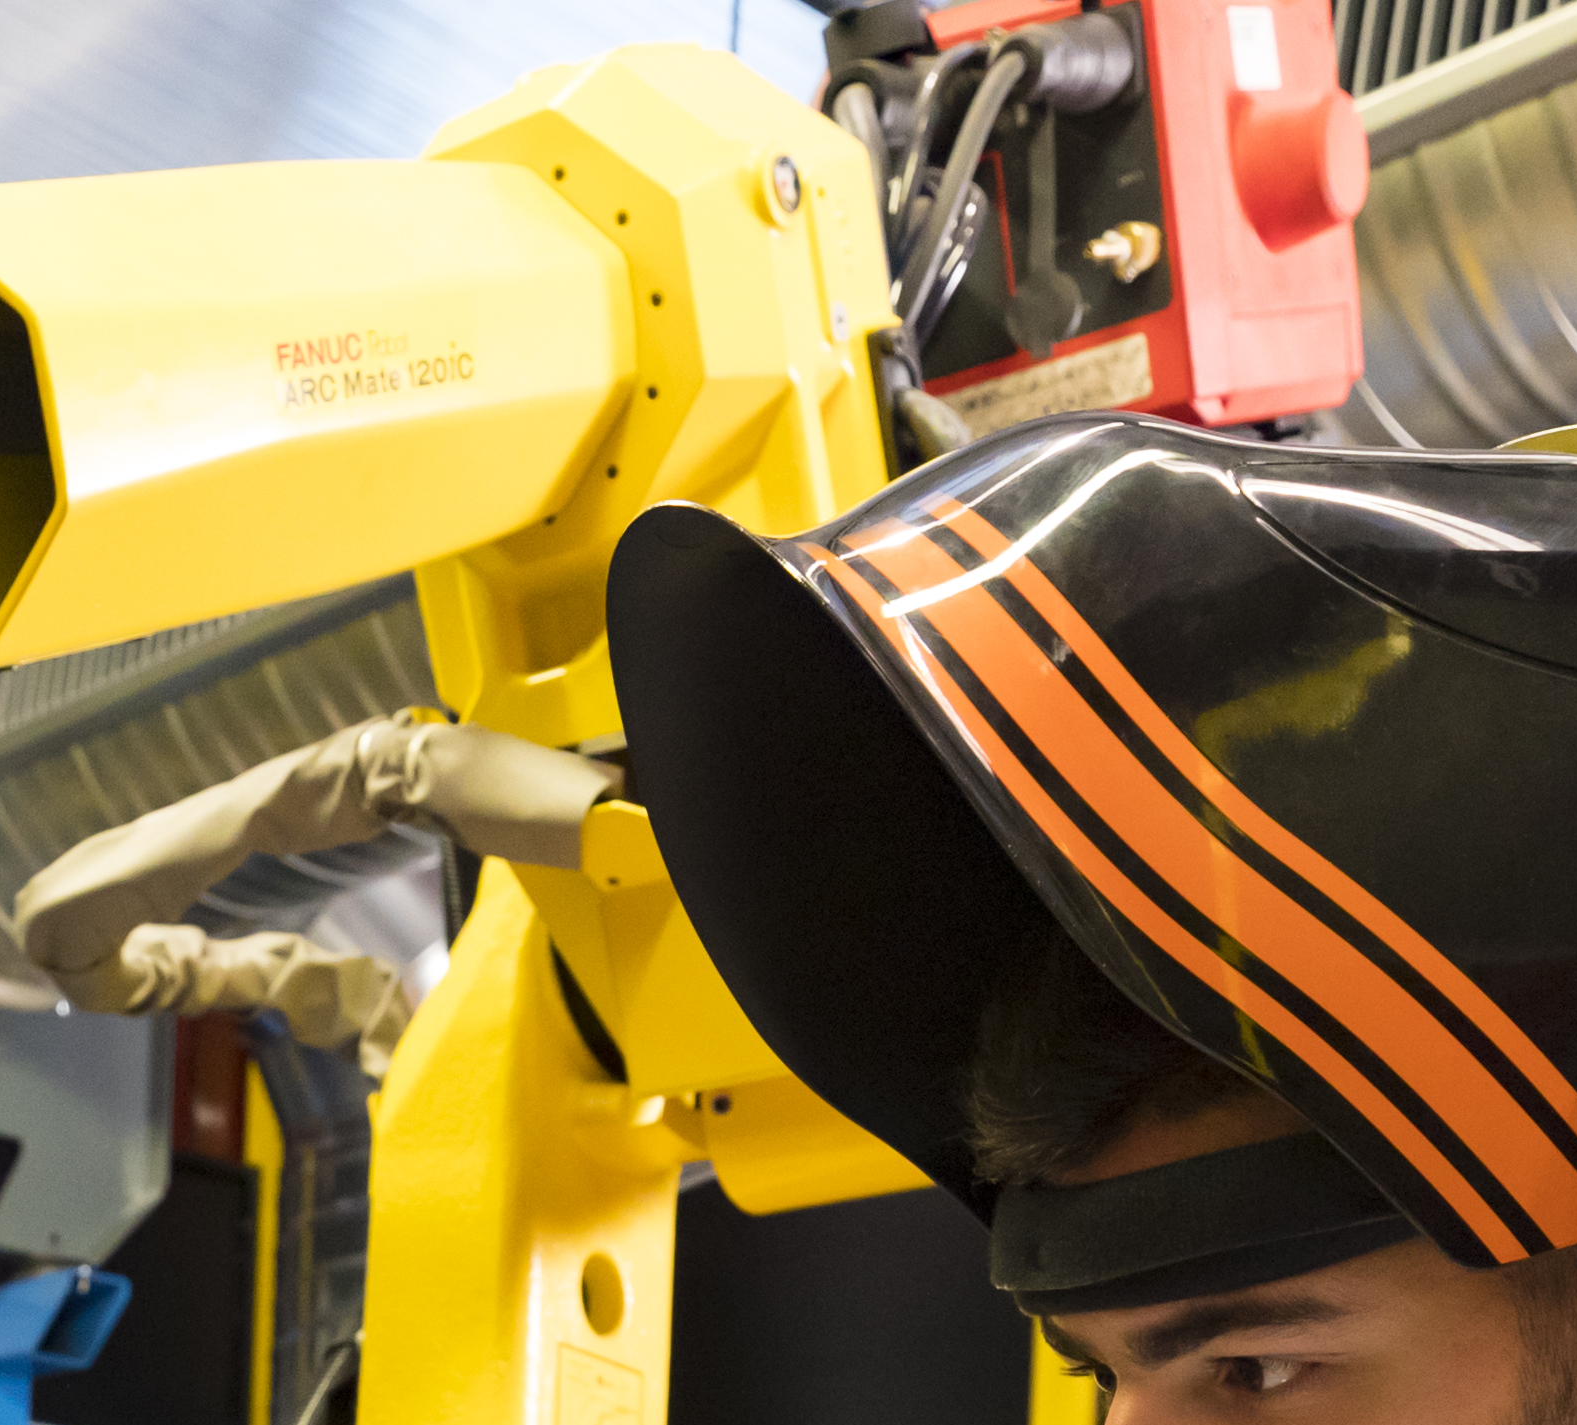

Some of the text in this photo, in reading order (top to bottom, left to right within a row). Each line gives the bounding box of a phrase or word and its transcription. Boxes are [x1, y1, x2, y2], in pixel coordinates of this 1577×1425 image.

[276, 333, 364, 372] FANUC
[281, 369, 337, 410] ARC
[343, 362, 401, 401] Mate
